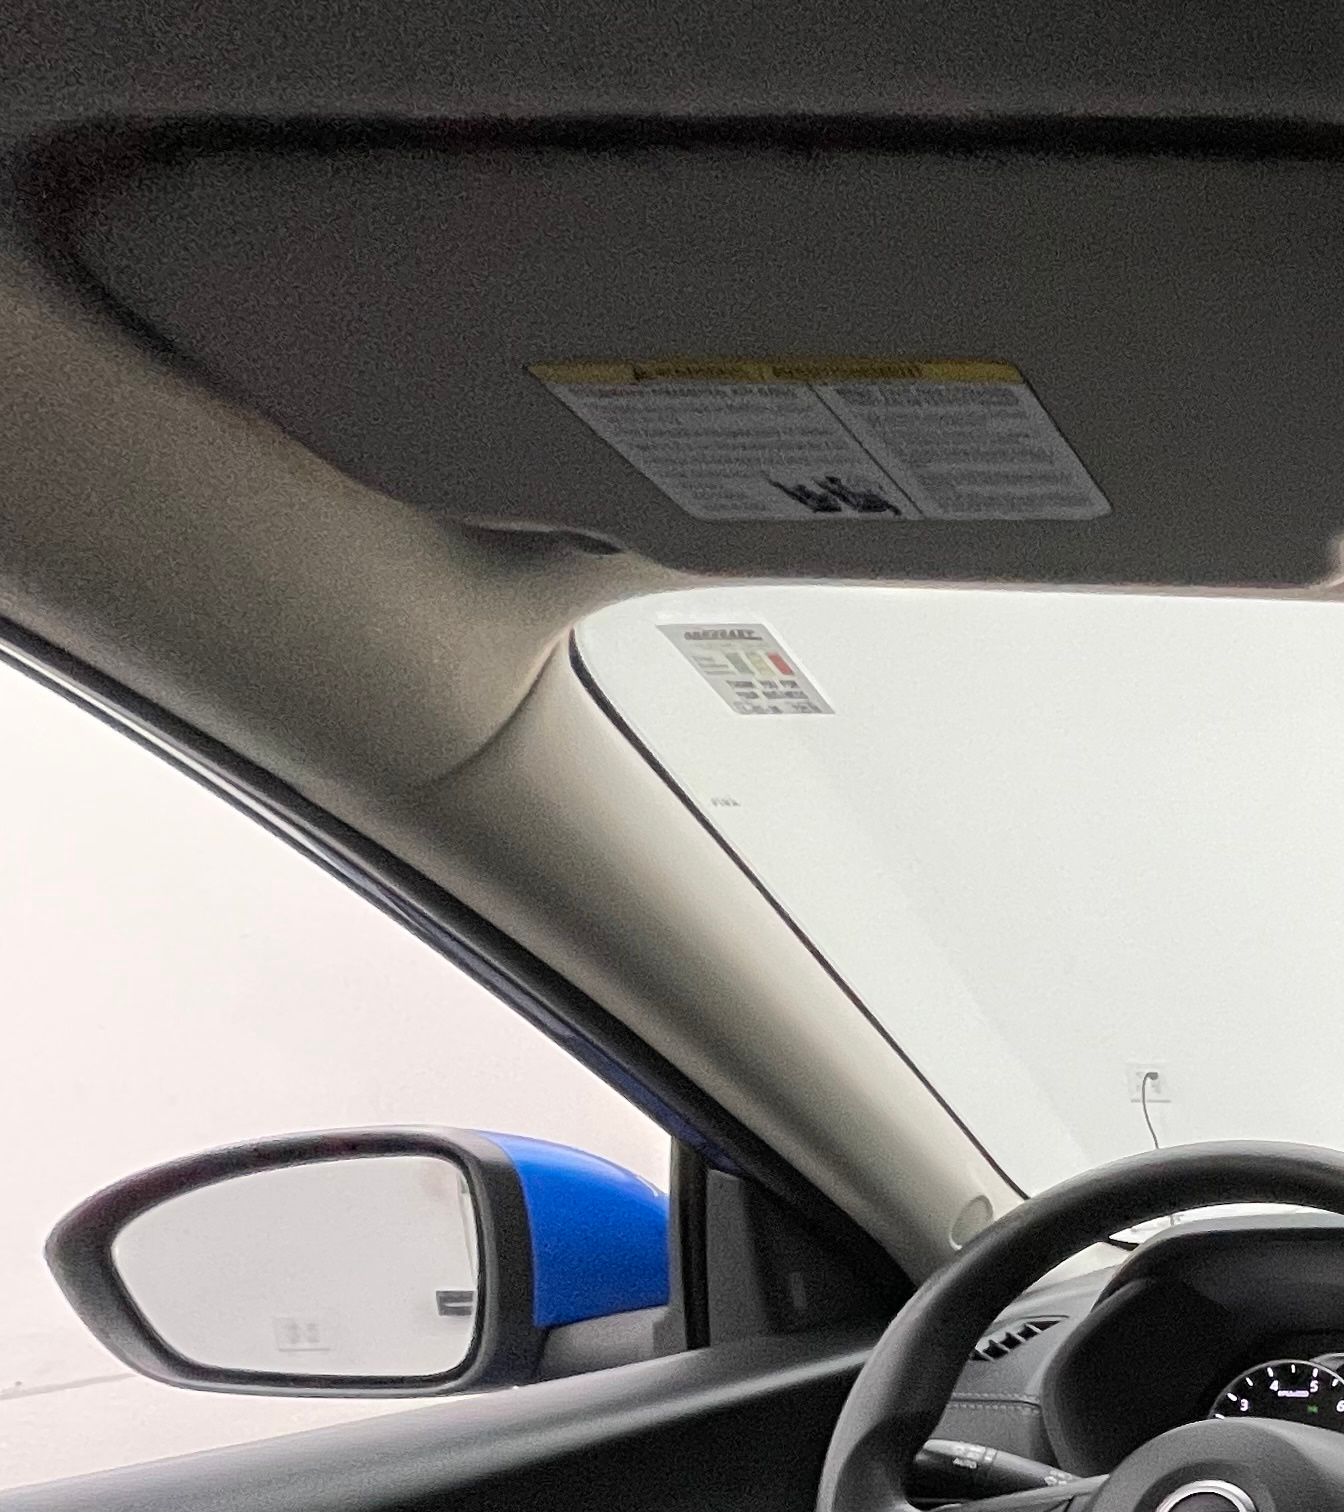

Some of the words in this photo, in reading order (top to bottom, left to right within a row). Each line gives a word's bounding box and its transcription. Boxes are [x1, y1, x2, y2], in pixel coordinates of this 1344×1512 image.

[1269, 1379, 1279, 1392] 4
[1309, 1379, 1319, 1393] 5
[1239, 1398, 1249, 1412] 3
